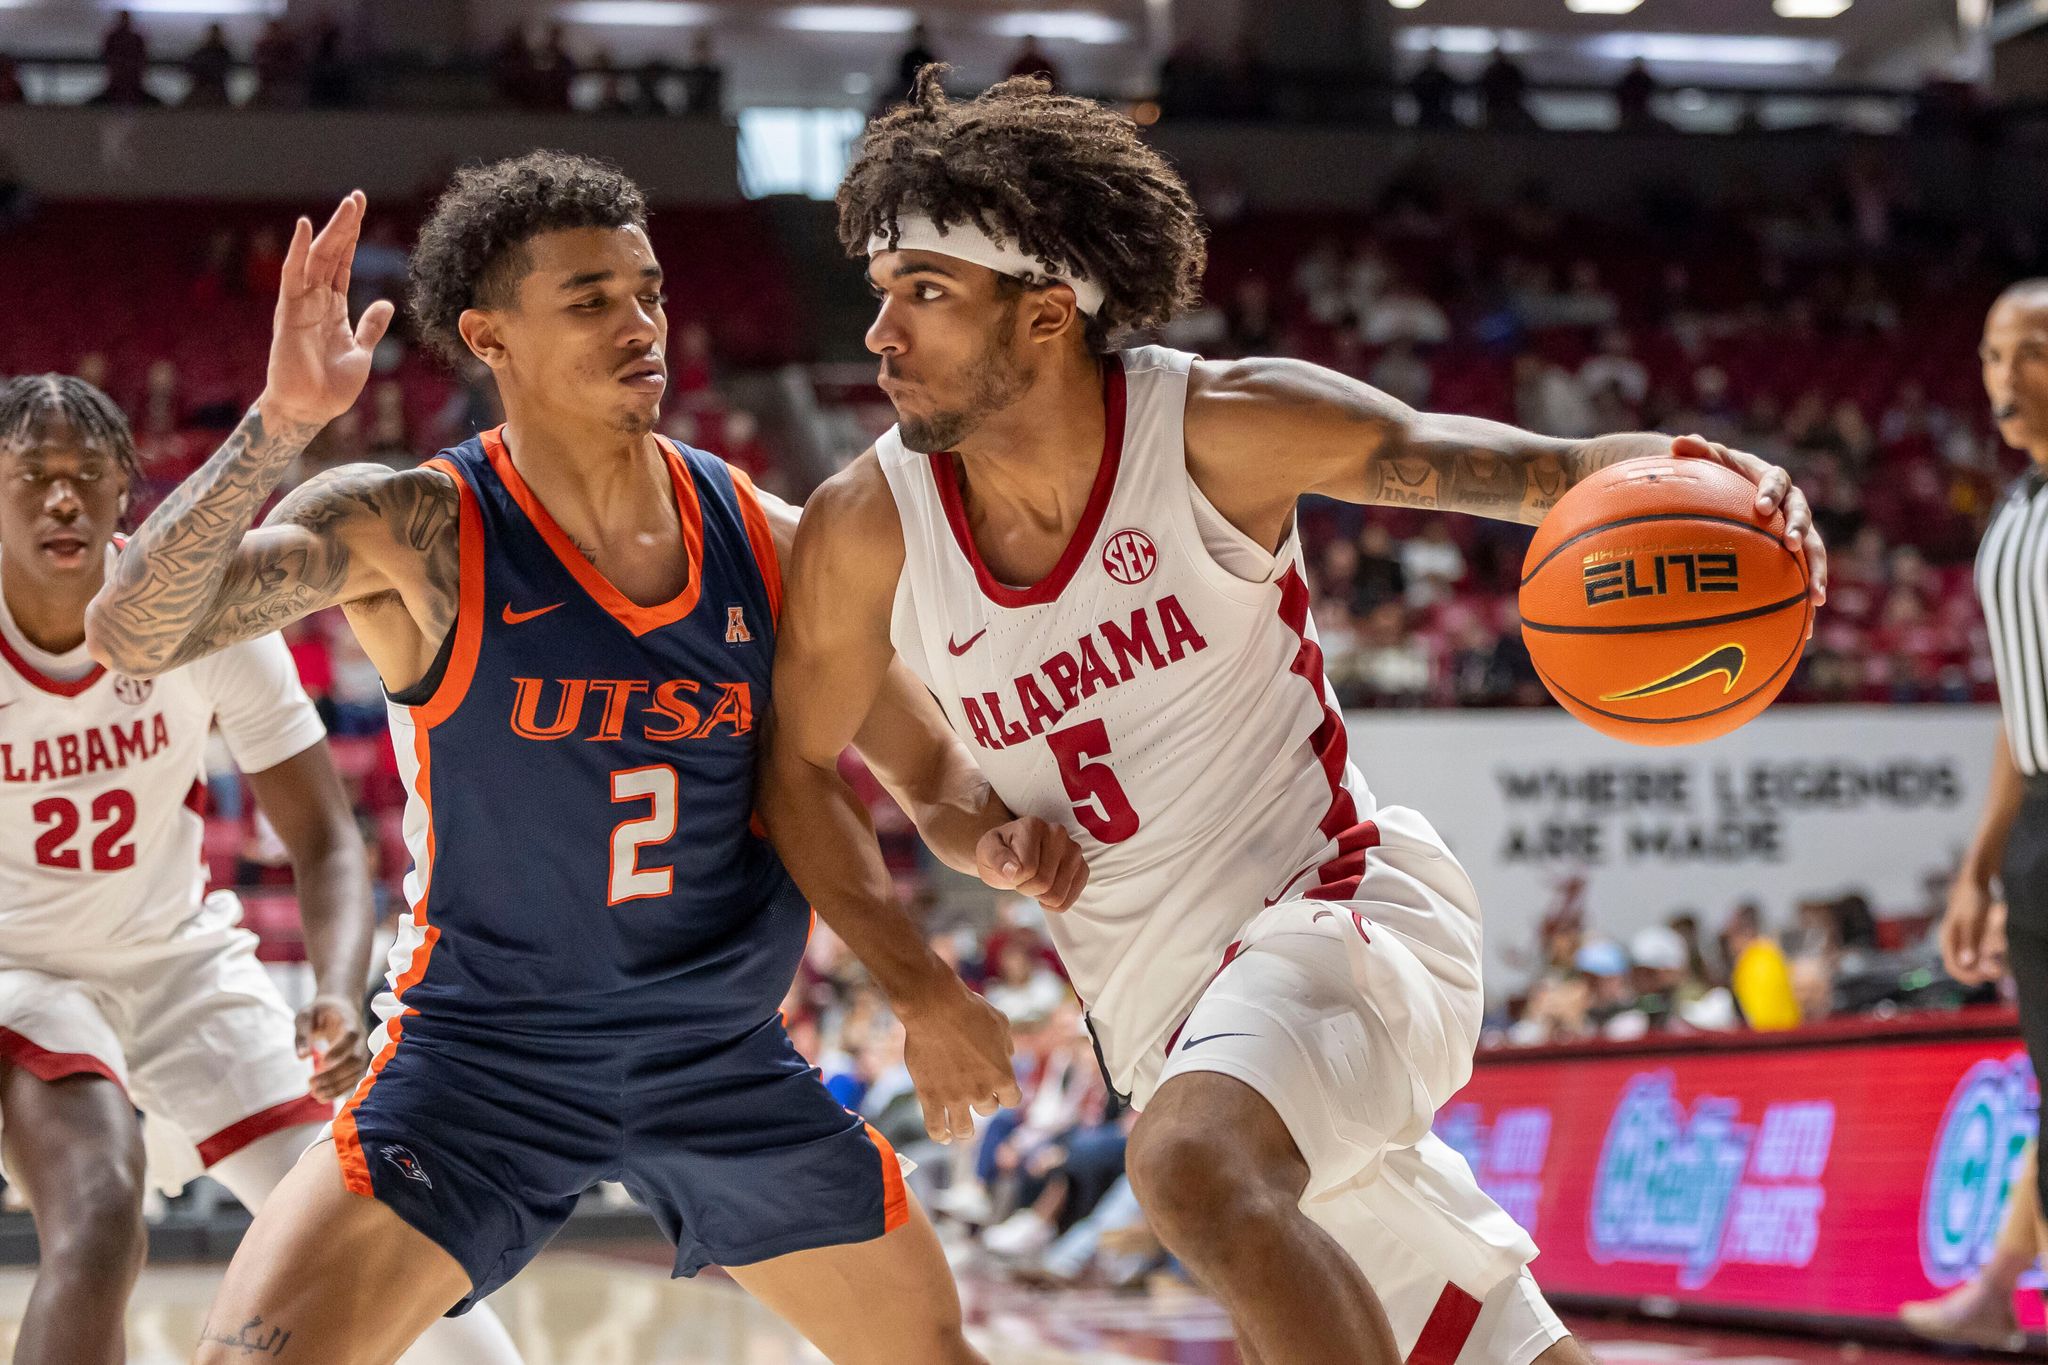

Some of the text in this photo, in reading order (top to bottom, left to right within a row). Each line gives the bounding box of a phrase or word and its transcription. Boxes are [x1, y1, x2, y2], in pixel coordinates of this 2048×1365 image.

[1104, 530, 1156, 585] SEC
[1584, 553, 1739, 607] ELITE
[961, 594, 1208, 750] ALABAMA
[510, 678, 753, 742] UTSA
[1046, 717, 1140, 844] 5
[1498, 760, 1964, 808] WHERE LEGENDS
[33, 788, 137, 871] 22
[607, 763, 679, 907] 2
[1501, 819, 1784, 861] ARE MADE
